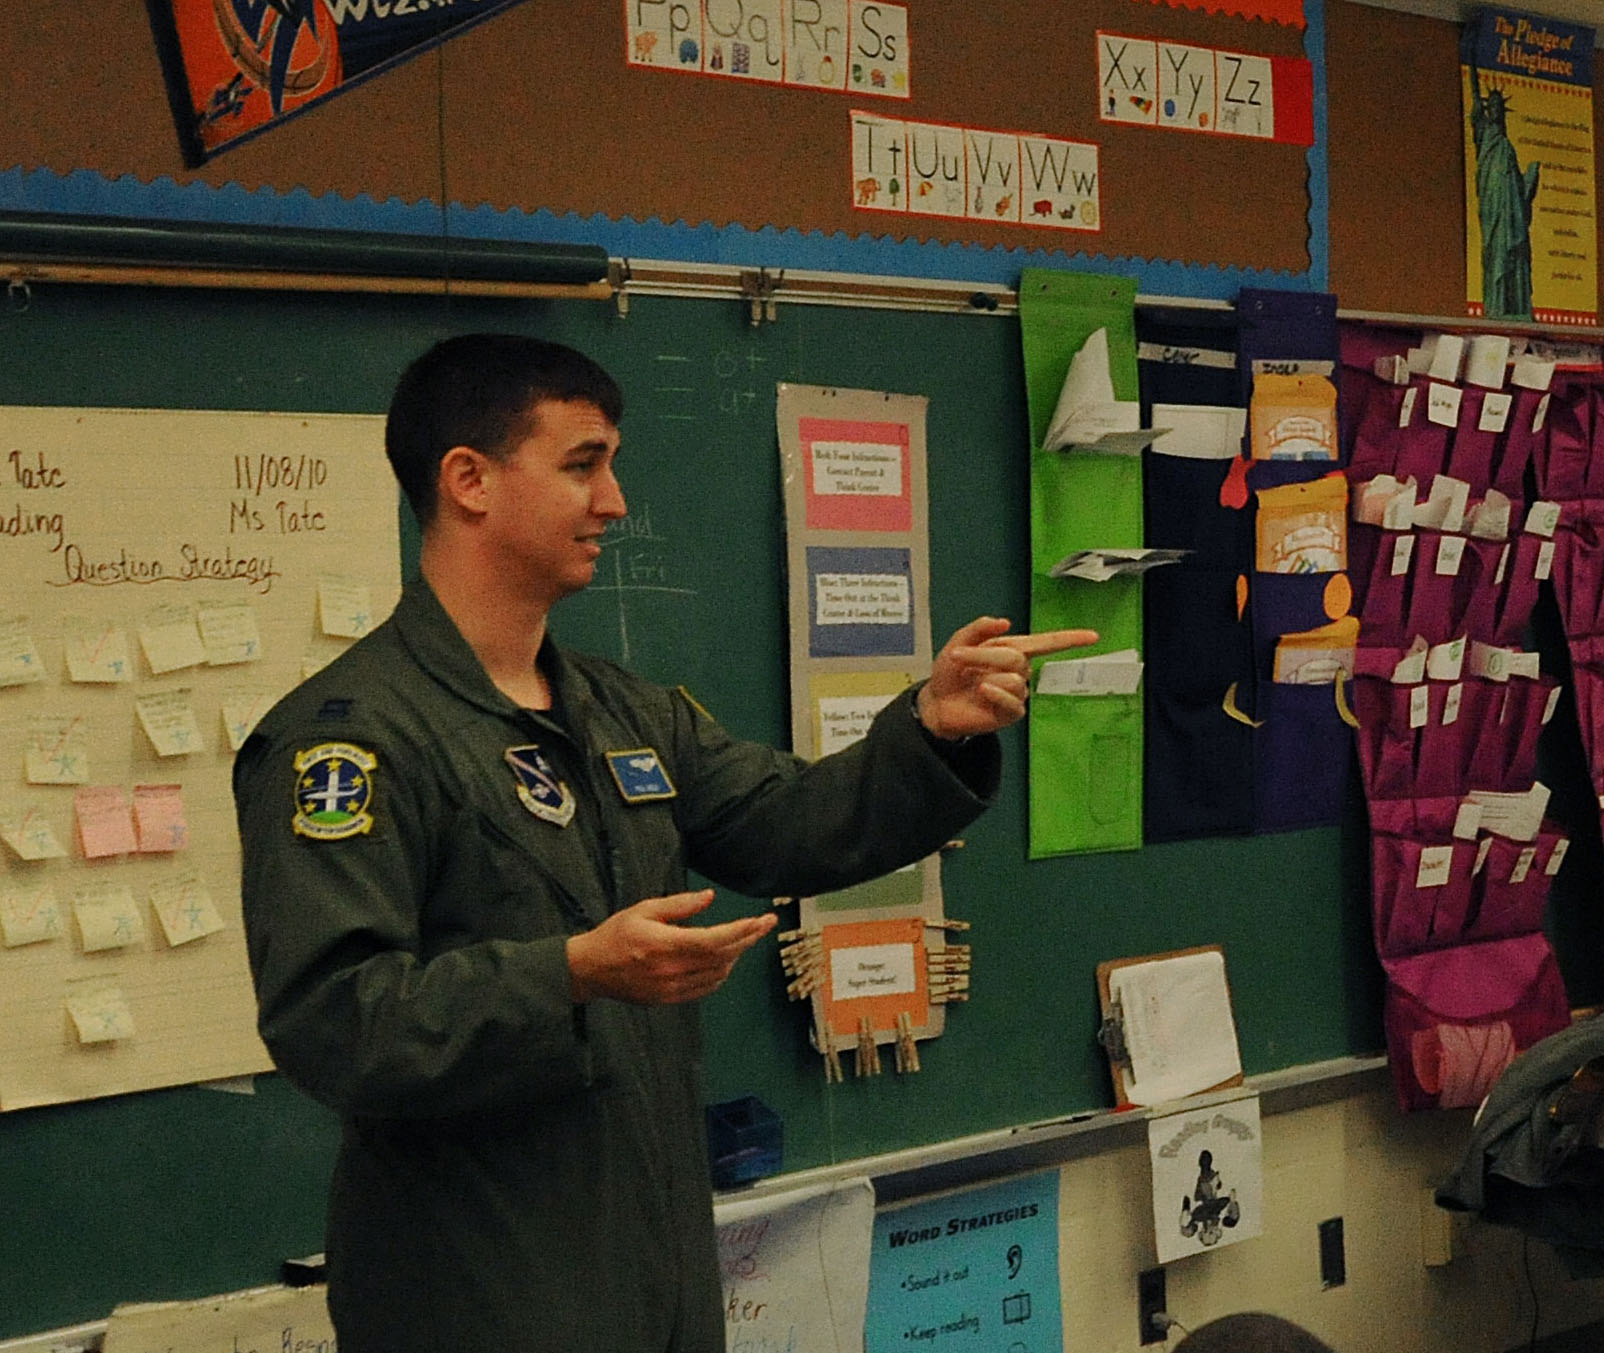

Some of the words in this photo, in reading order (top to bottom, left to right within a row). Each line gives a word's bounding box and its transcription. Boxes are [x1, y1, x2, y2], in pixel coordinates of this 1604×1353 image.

[857, 8, 897, 62] Ss
[1495, 16, 1514, 38] The
[1515, 20, 1558, 53] Pledge
[1558, 34, 1573, 51] of
[1497, 39, 1573, 77] Allegiance
[1104, 40, 1147, 92] Xx
[1165, 50, 1204, 120] Yy
[1224, 57, 1261, 106] Zz
[855, 120, 901, 176] Tt
[912, 126, 958, 182] Uu
[972, 137, 1012, 187] Vv
[1024, 144, 1096, 197] Ww
[235, 453, 328, 496] 11/08/10
[229, 501, 265, 534] Ms
[65, 544, 163, 582] Question
[180, 544, 276, 594] Strategy
[889, 1226, 941, 1248] WORD
[946, 1203, 1039, 1236] STRATEGIES
[907, 1270, 940, 1292] Sound
[952, 1266, 969, 1281] out
[909, 1326, 937, 1345] Keep
[940, 1313, 980, 1334] reading
